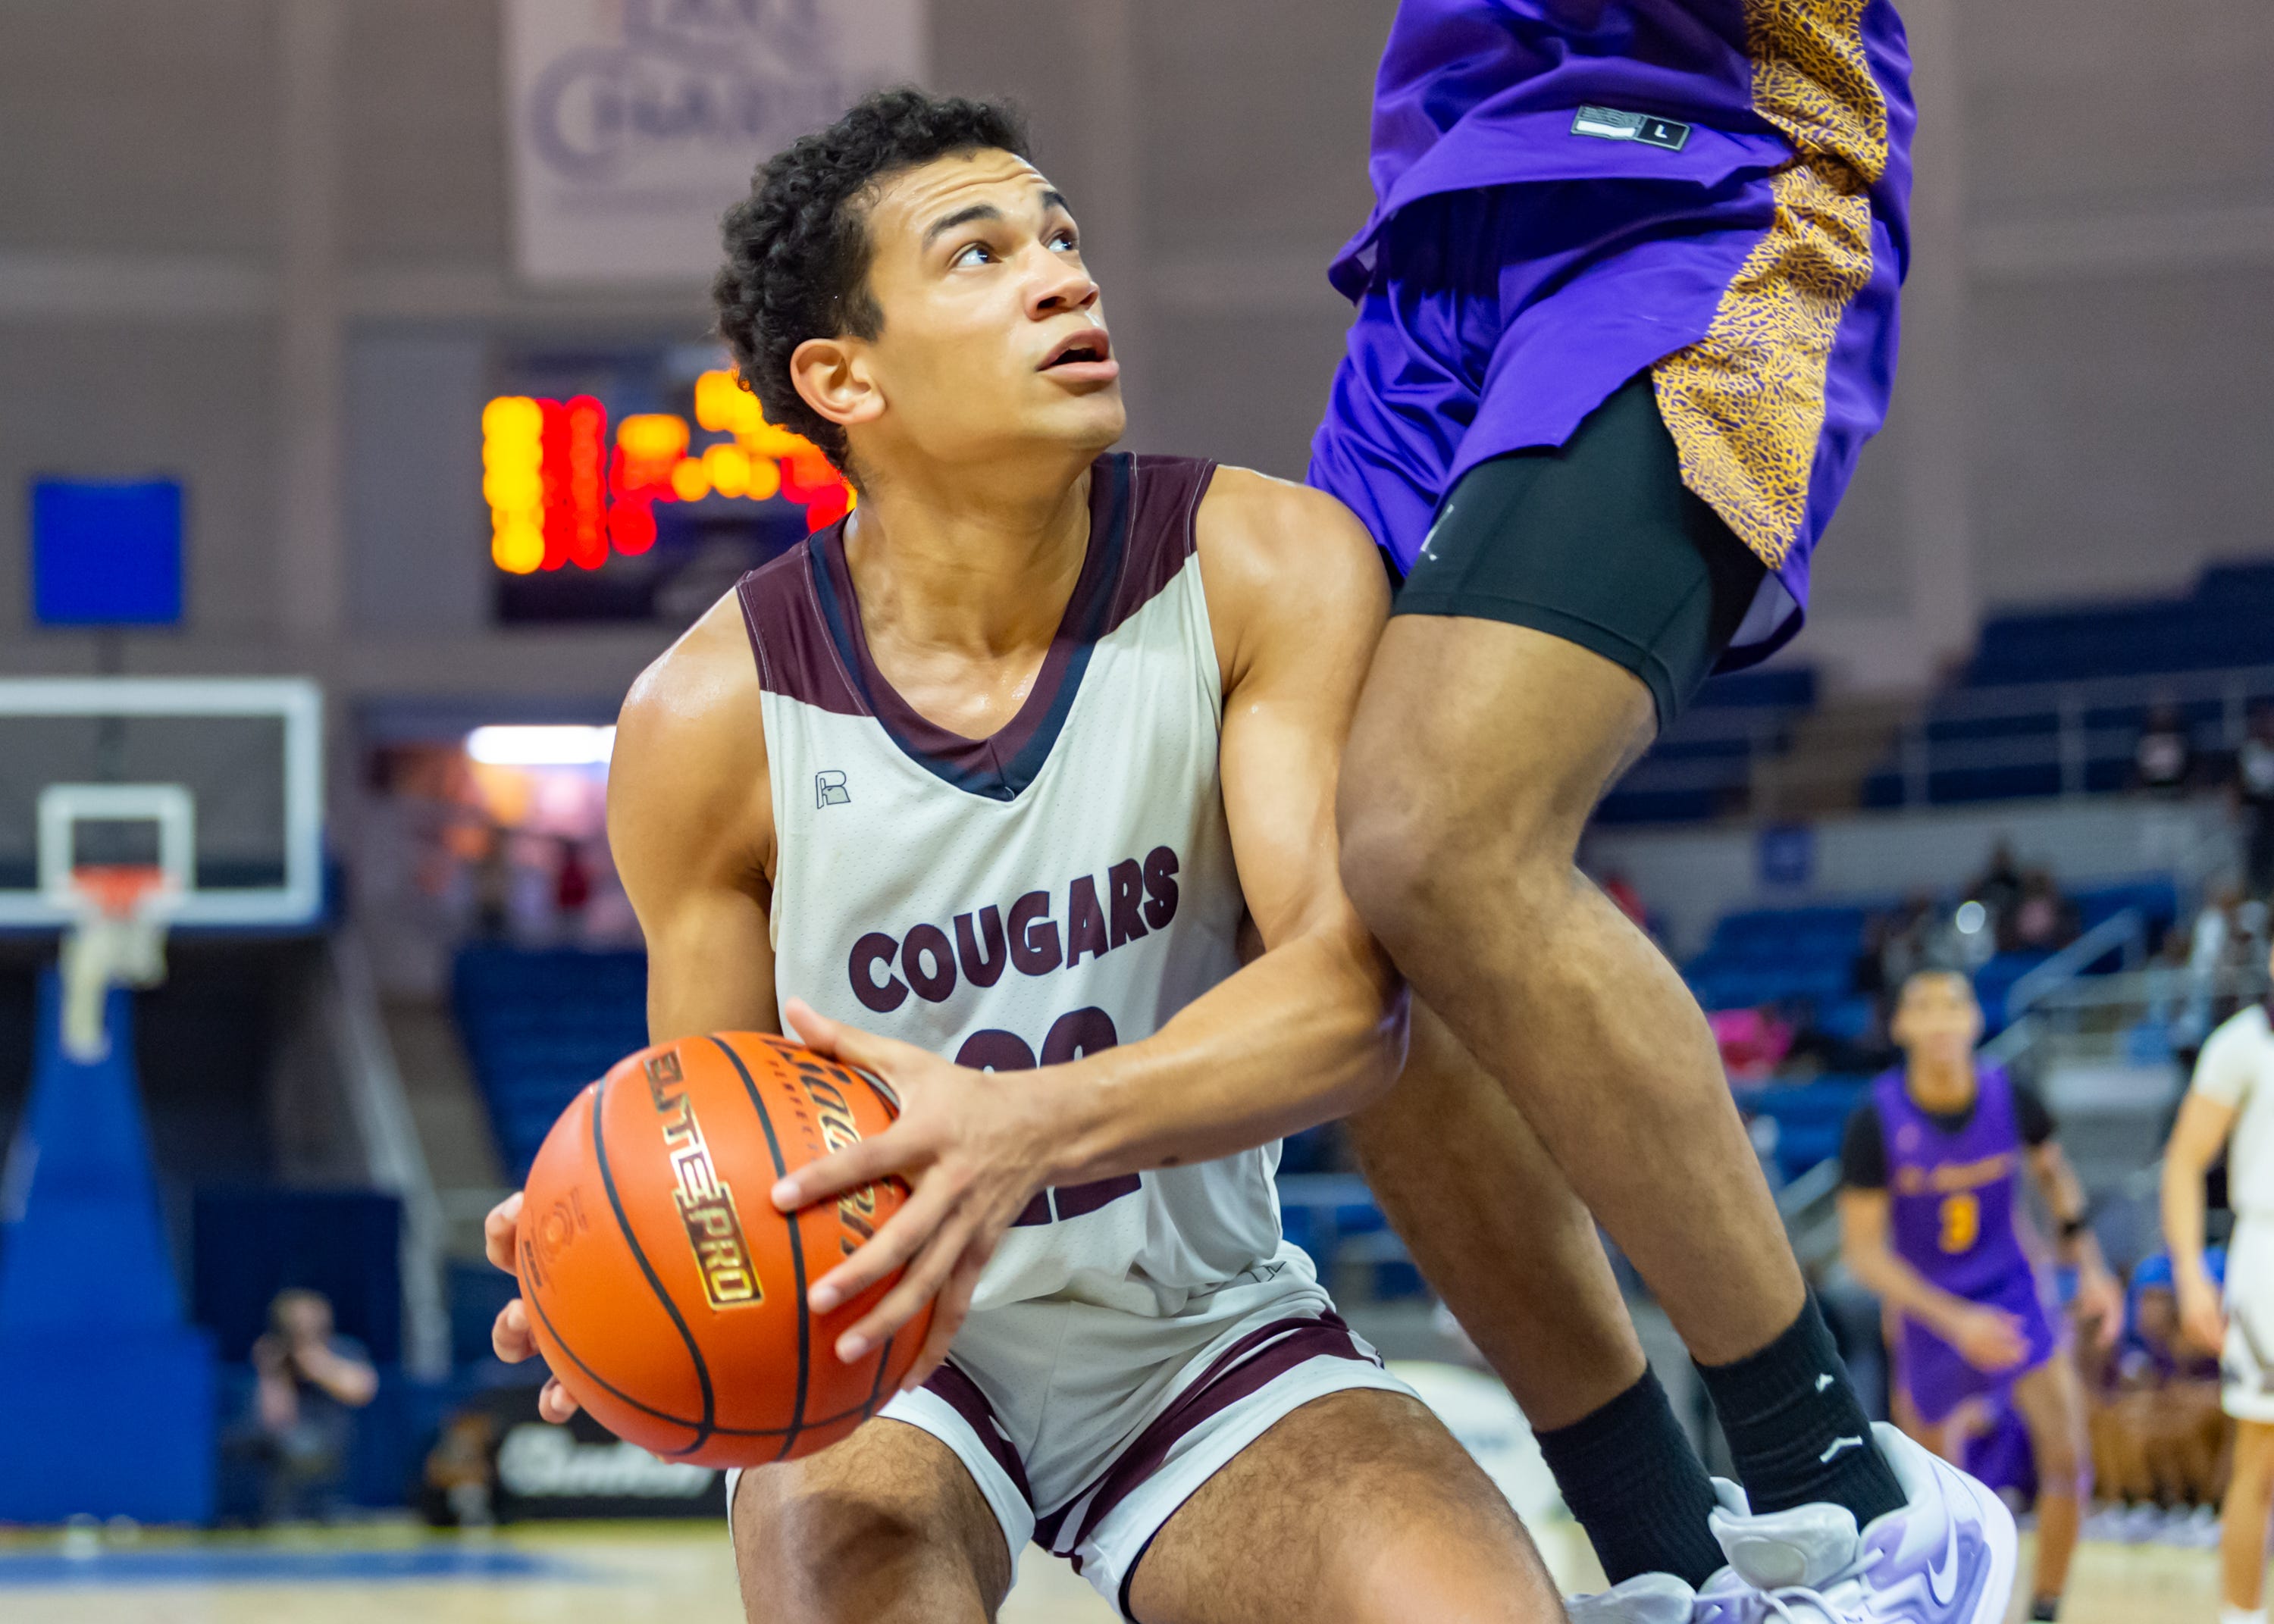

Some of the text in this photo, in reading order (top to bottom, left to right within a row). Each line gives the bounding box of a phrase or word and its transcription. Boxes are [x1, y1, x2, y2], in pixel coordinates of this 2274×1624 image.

[1653, 124, 1668, 139] L
[848, 845, 1179, 1013] COUGARS
[688, 1198, 758, 1304] PRO
